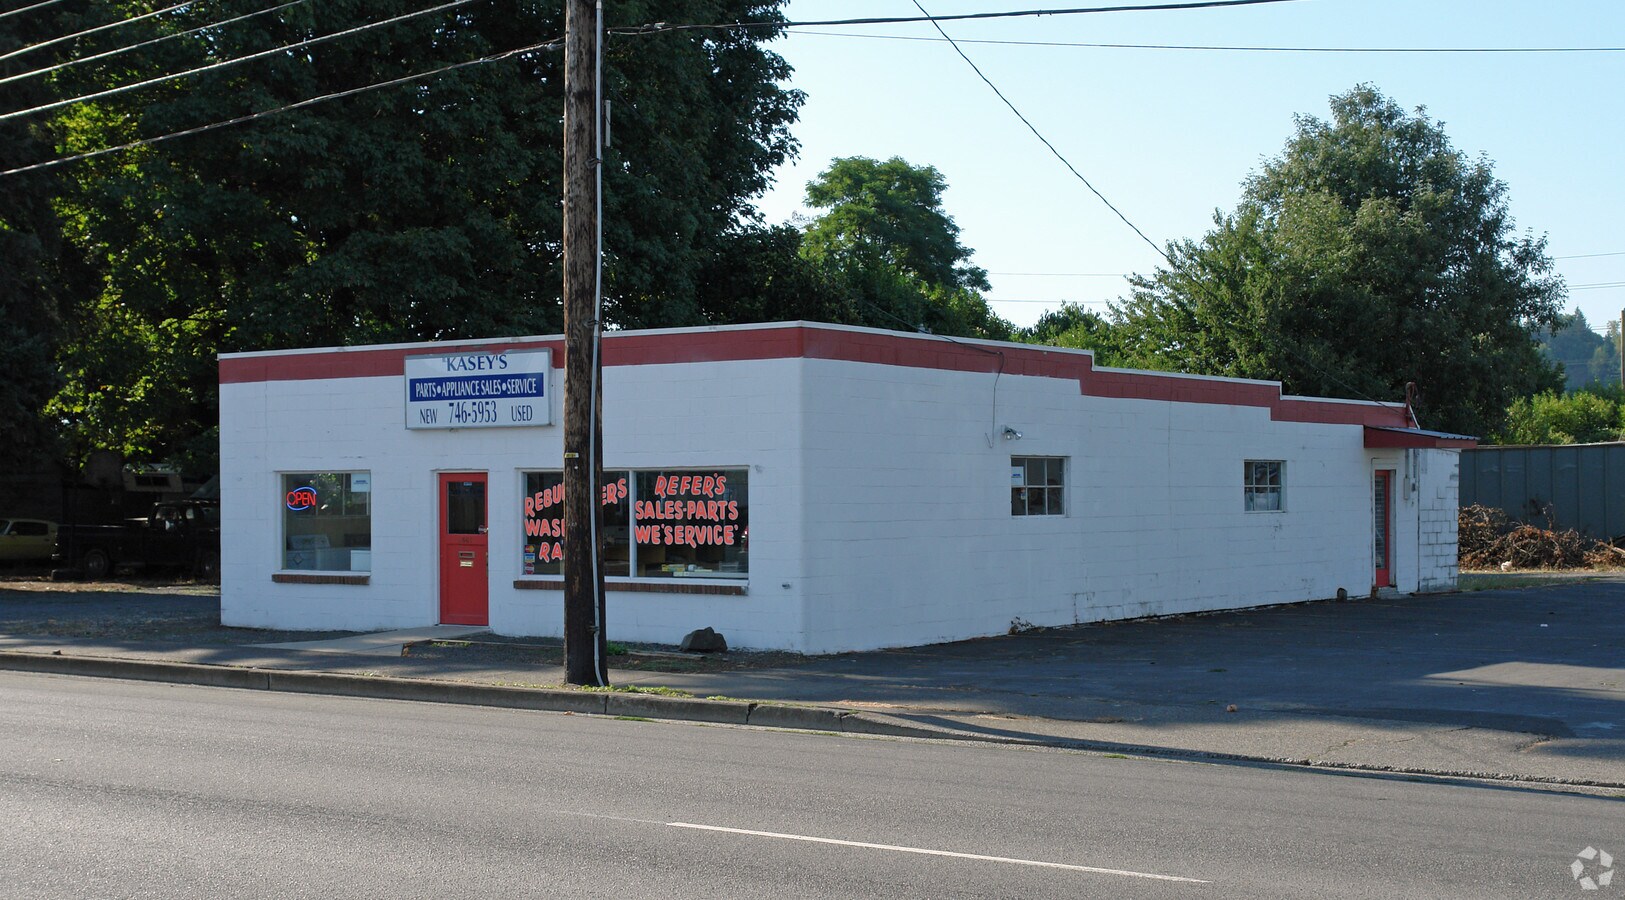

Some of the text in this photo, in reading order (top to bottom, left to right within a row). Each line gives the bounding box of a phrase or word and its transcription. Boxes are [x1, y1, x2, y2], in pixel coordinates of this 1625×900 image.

[445, 354, 508, 372] KASEY'S
[415, 377, 537, 398] PARTS APPLIANCE SALES SERVICE
[419, 400, 533, 424] NEW 746-5953 USED
[655, 472, 727, 498] REFER'S
[286, 491, 317, 506] OPEN
